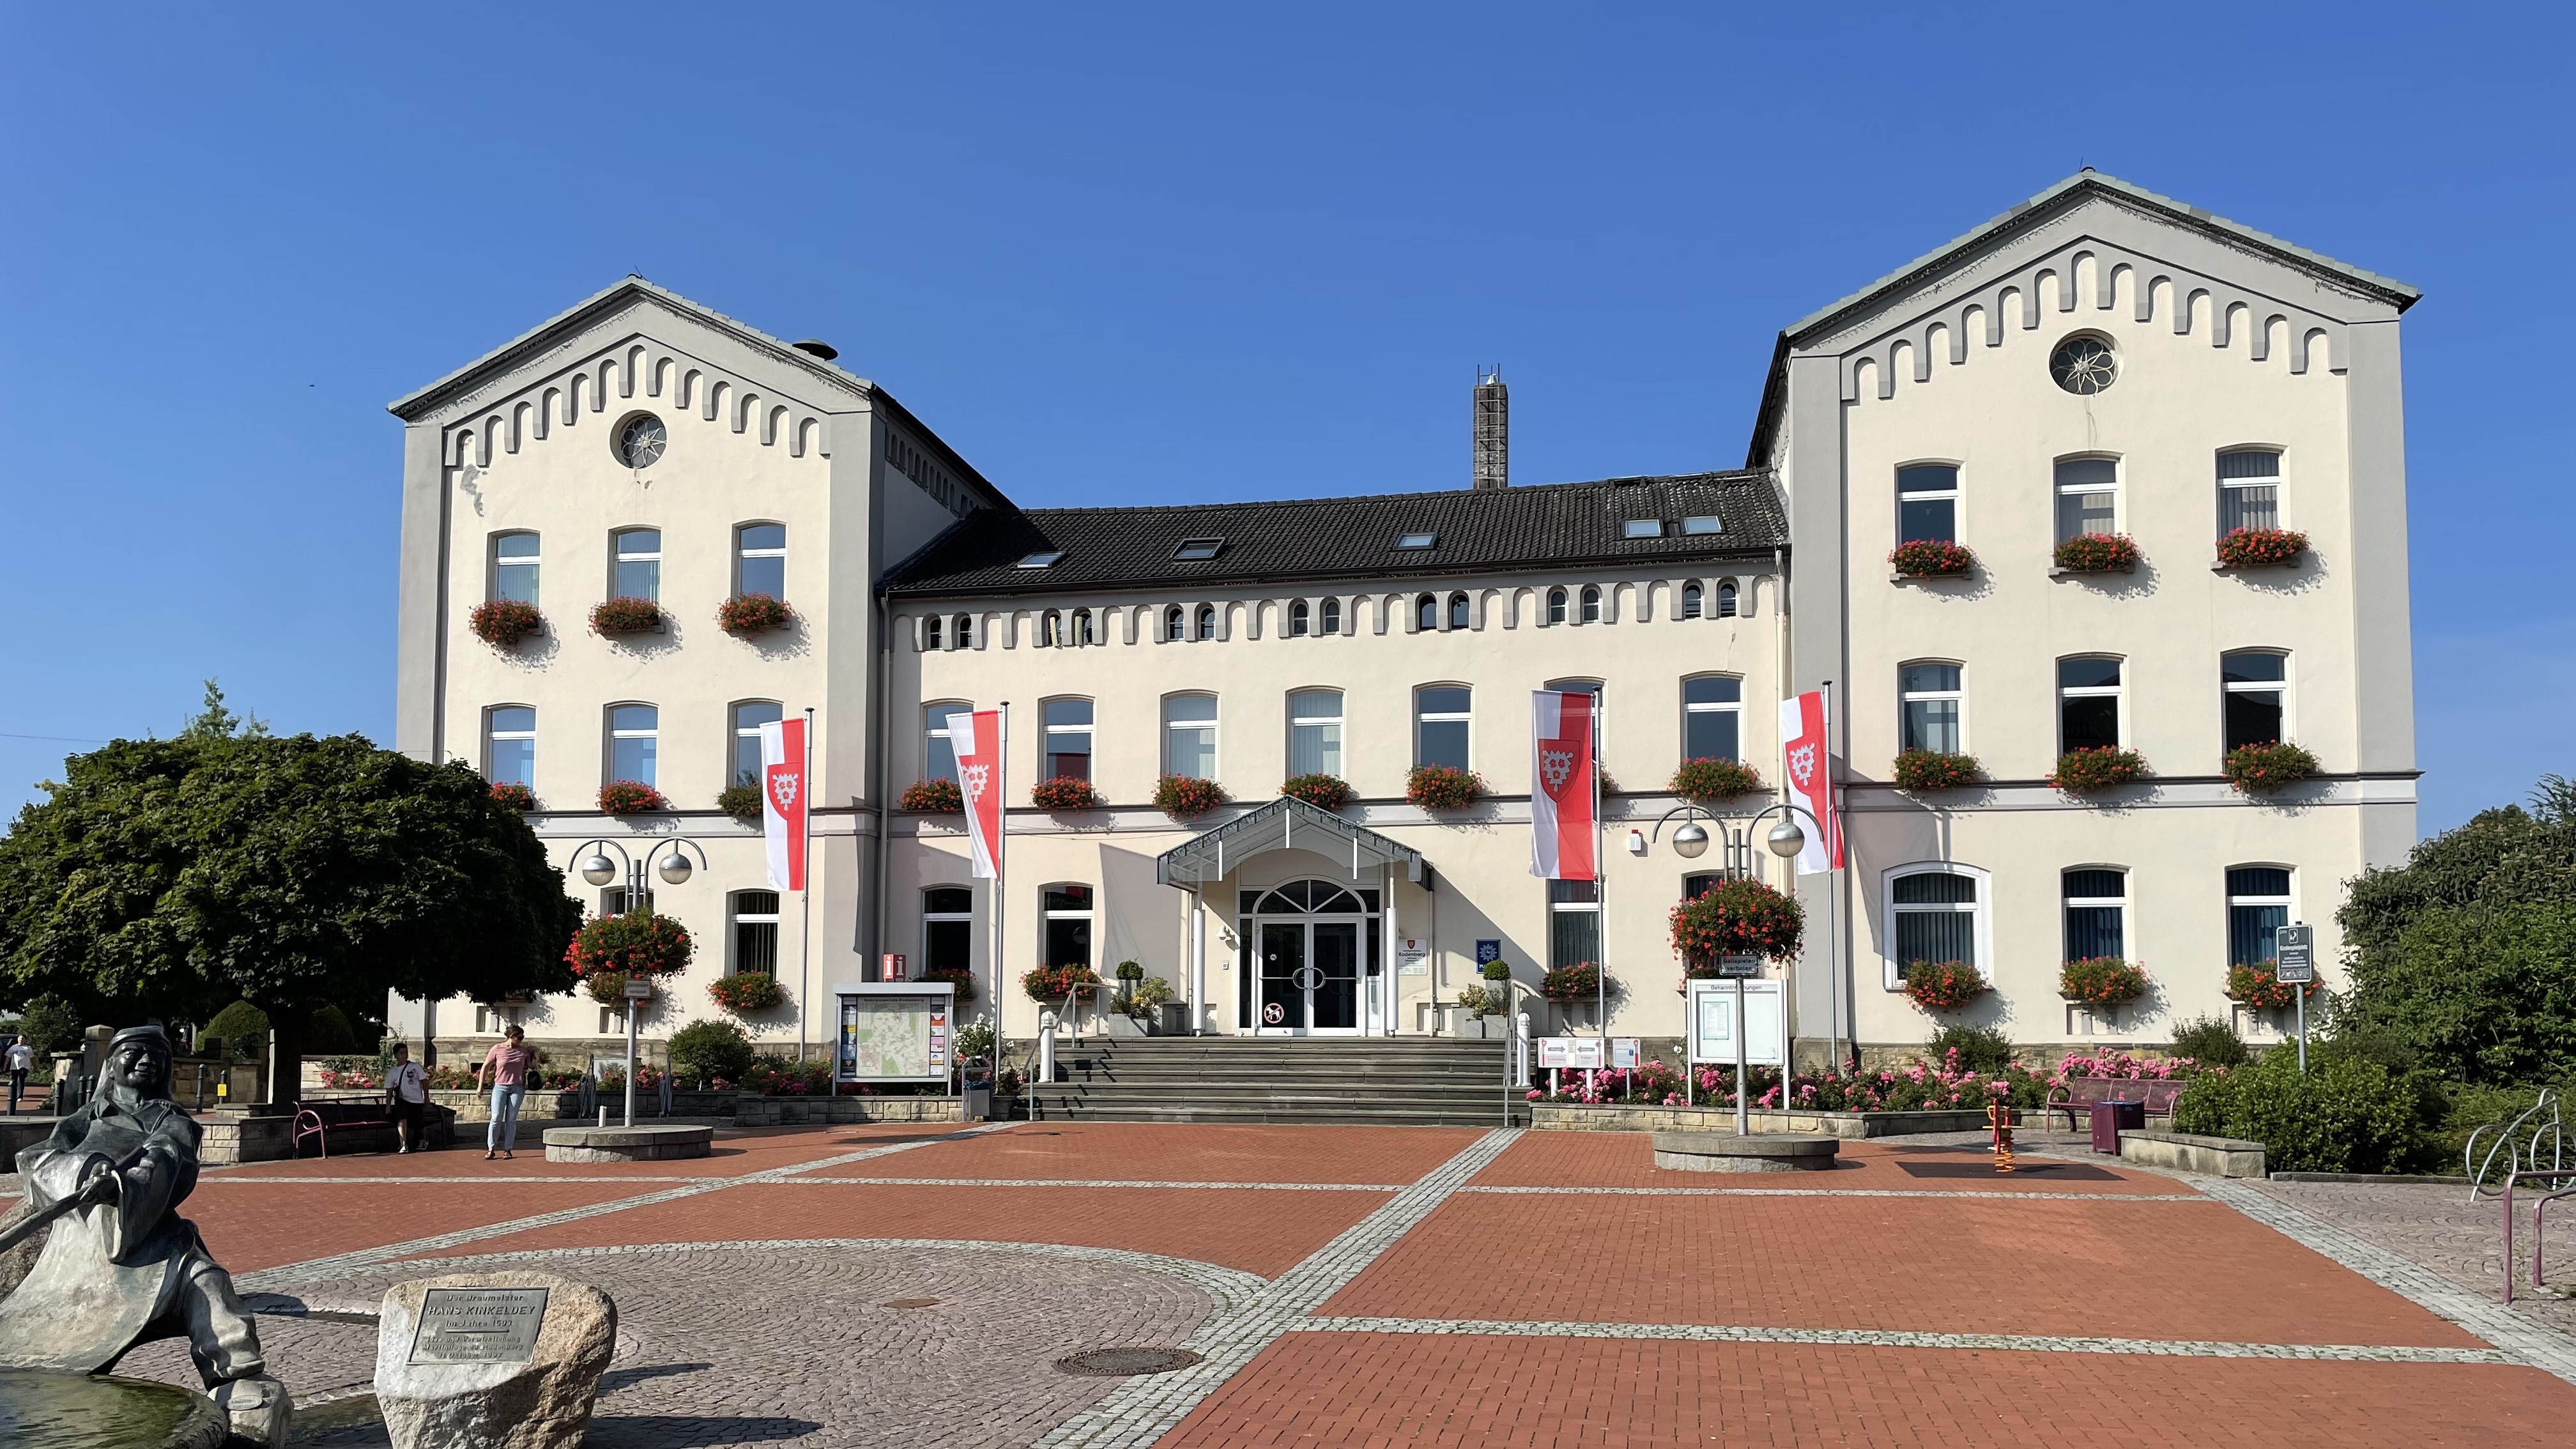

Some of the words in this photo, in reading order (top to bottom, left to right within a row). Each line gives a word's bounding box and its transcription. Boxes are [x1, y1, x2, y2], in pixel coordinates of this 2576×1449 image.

[885, 956, 892, 976] i
[896, 956, 904, 976] i
[428, 1306, 462, 1315] HANS
[466, 1306, 535, 1315] KINKELDEY
[463, 1335, 521, 1344] Verwirklichung
